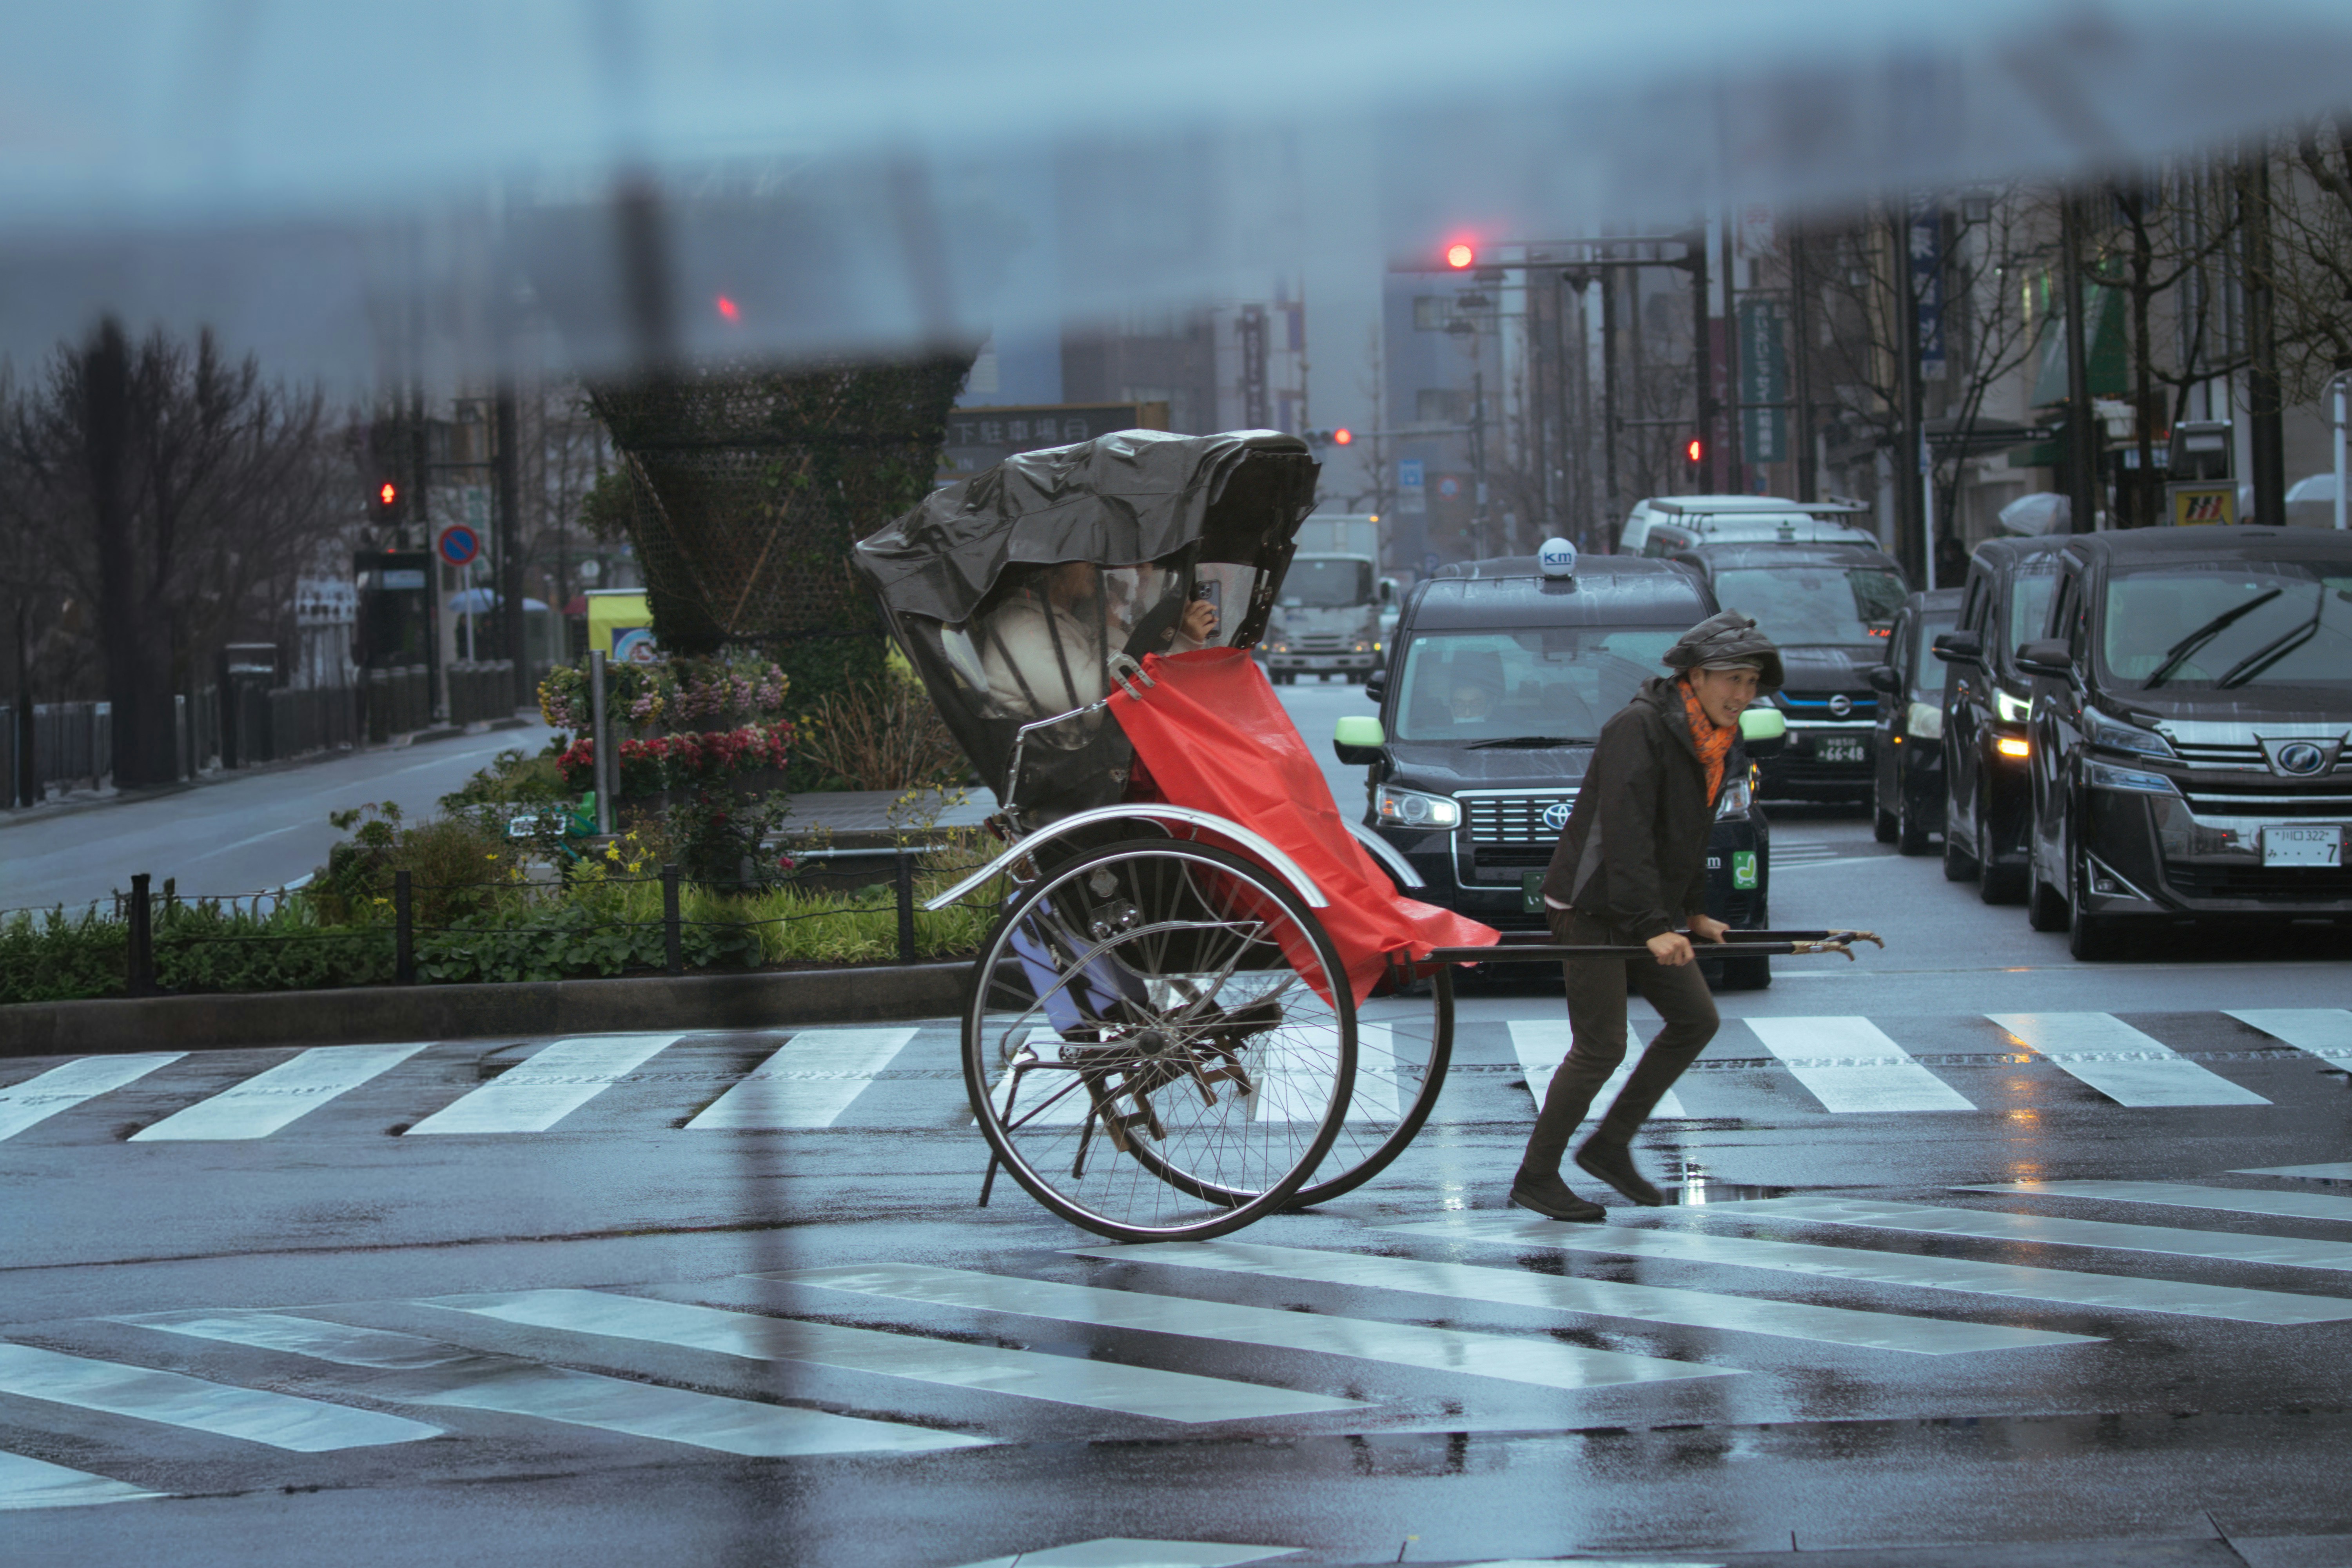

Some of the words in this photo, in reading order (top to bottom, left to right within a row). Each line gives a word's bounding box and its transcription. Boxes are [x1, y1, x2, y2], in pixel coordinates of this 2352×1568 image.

[1544, 552, 1572, 563] km
[1826, 746, 1864, 761] 66-48
[2282, 831, 2303, 841] 川口
[2306, 831, 2325, 841] 322
[1706, 857, 1721, 867] m
[1528, 895, 1539, 906] い
